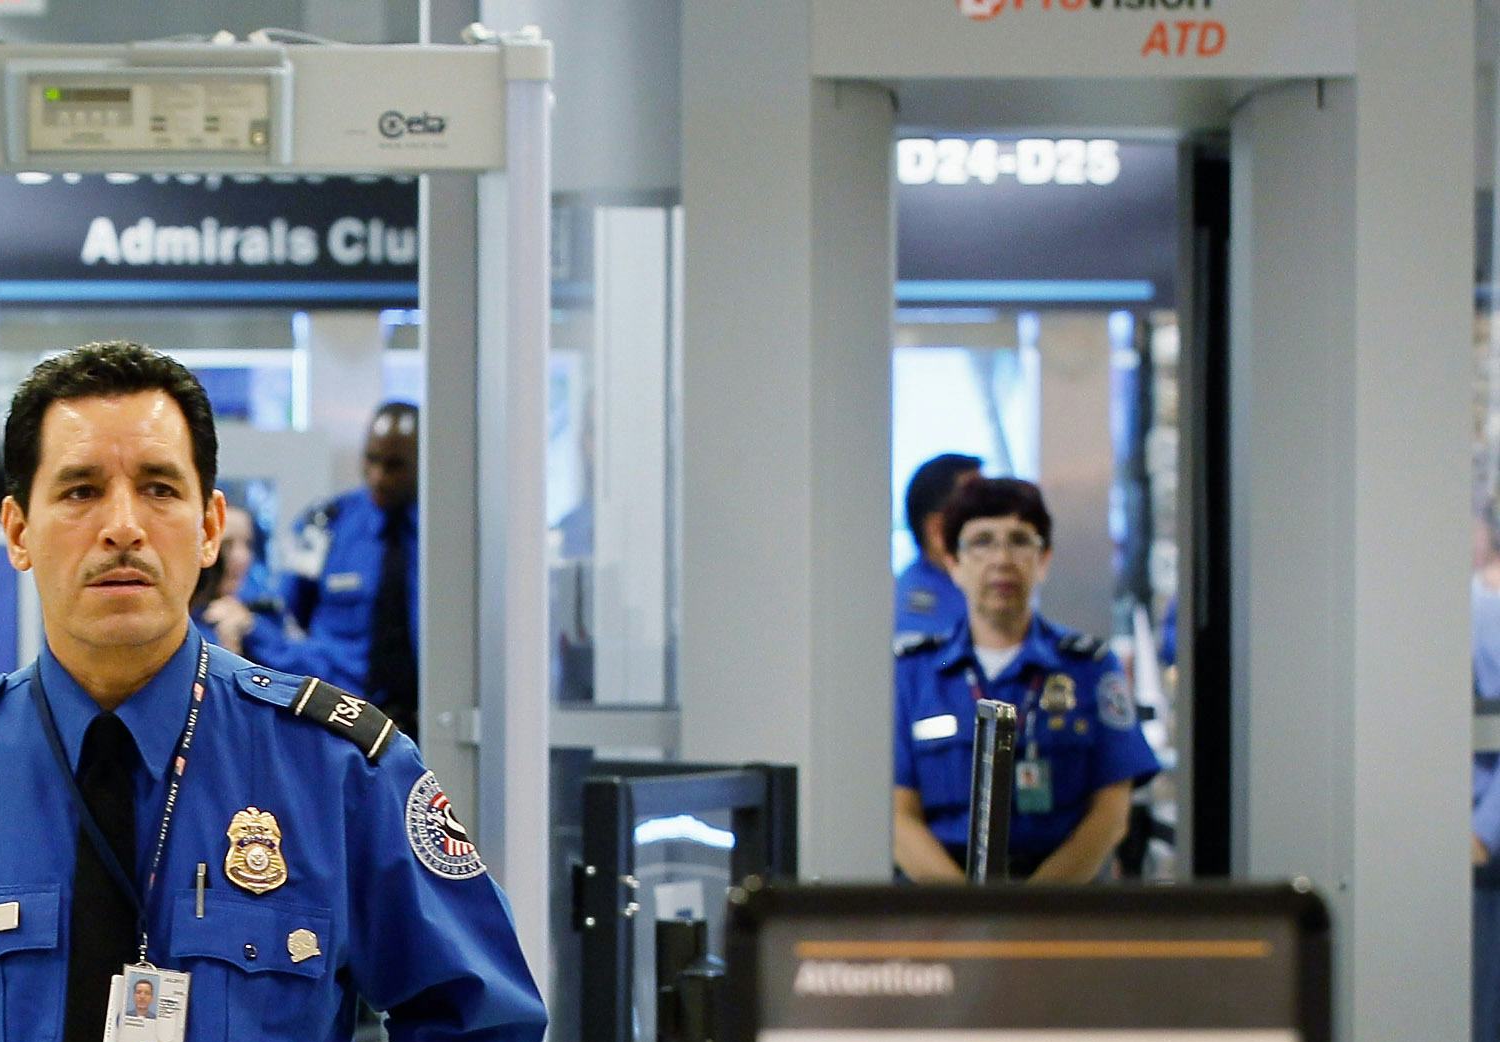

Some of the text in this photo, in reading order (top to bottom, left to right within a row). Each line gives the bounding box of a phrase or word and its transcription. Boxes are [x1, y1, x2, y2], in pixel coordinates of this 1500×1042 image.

[1141, 20, 1228, 57] ATD
[896, 138, 1121, 185] D24-D25
[79, 215, 418, 266] Admirals Clu
[328, 694, 366, 727] TSA
[795, 961, 954, 996] Attention
